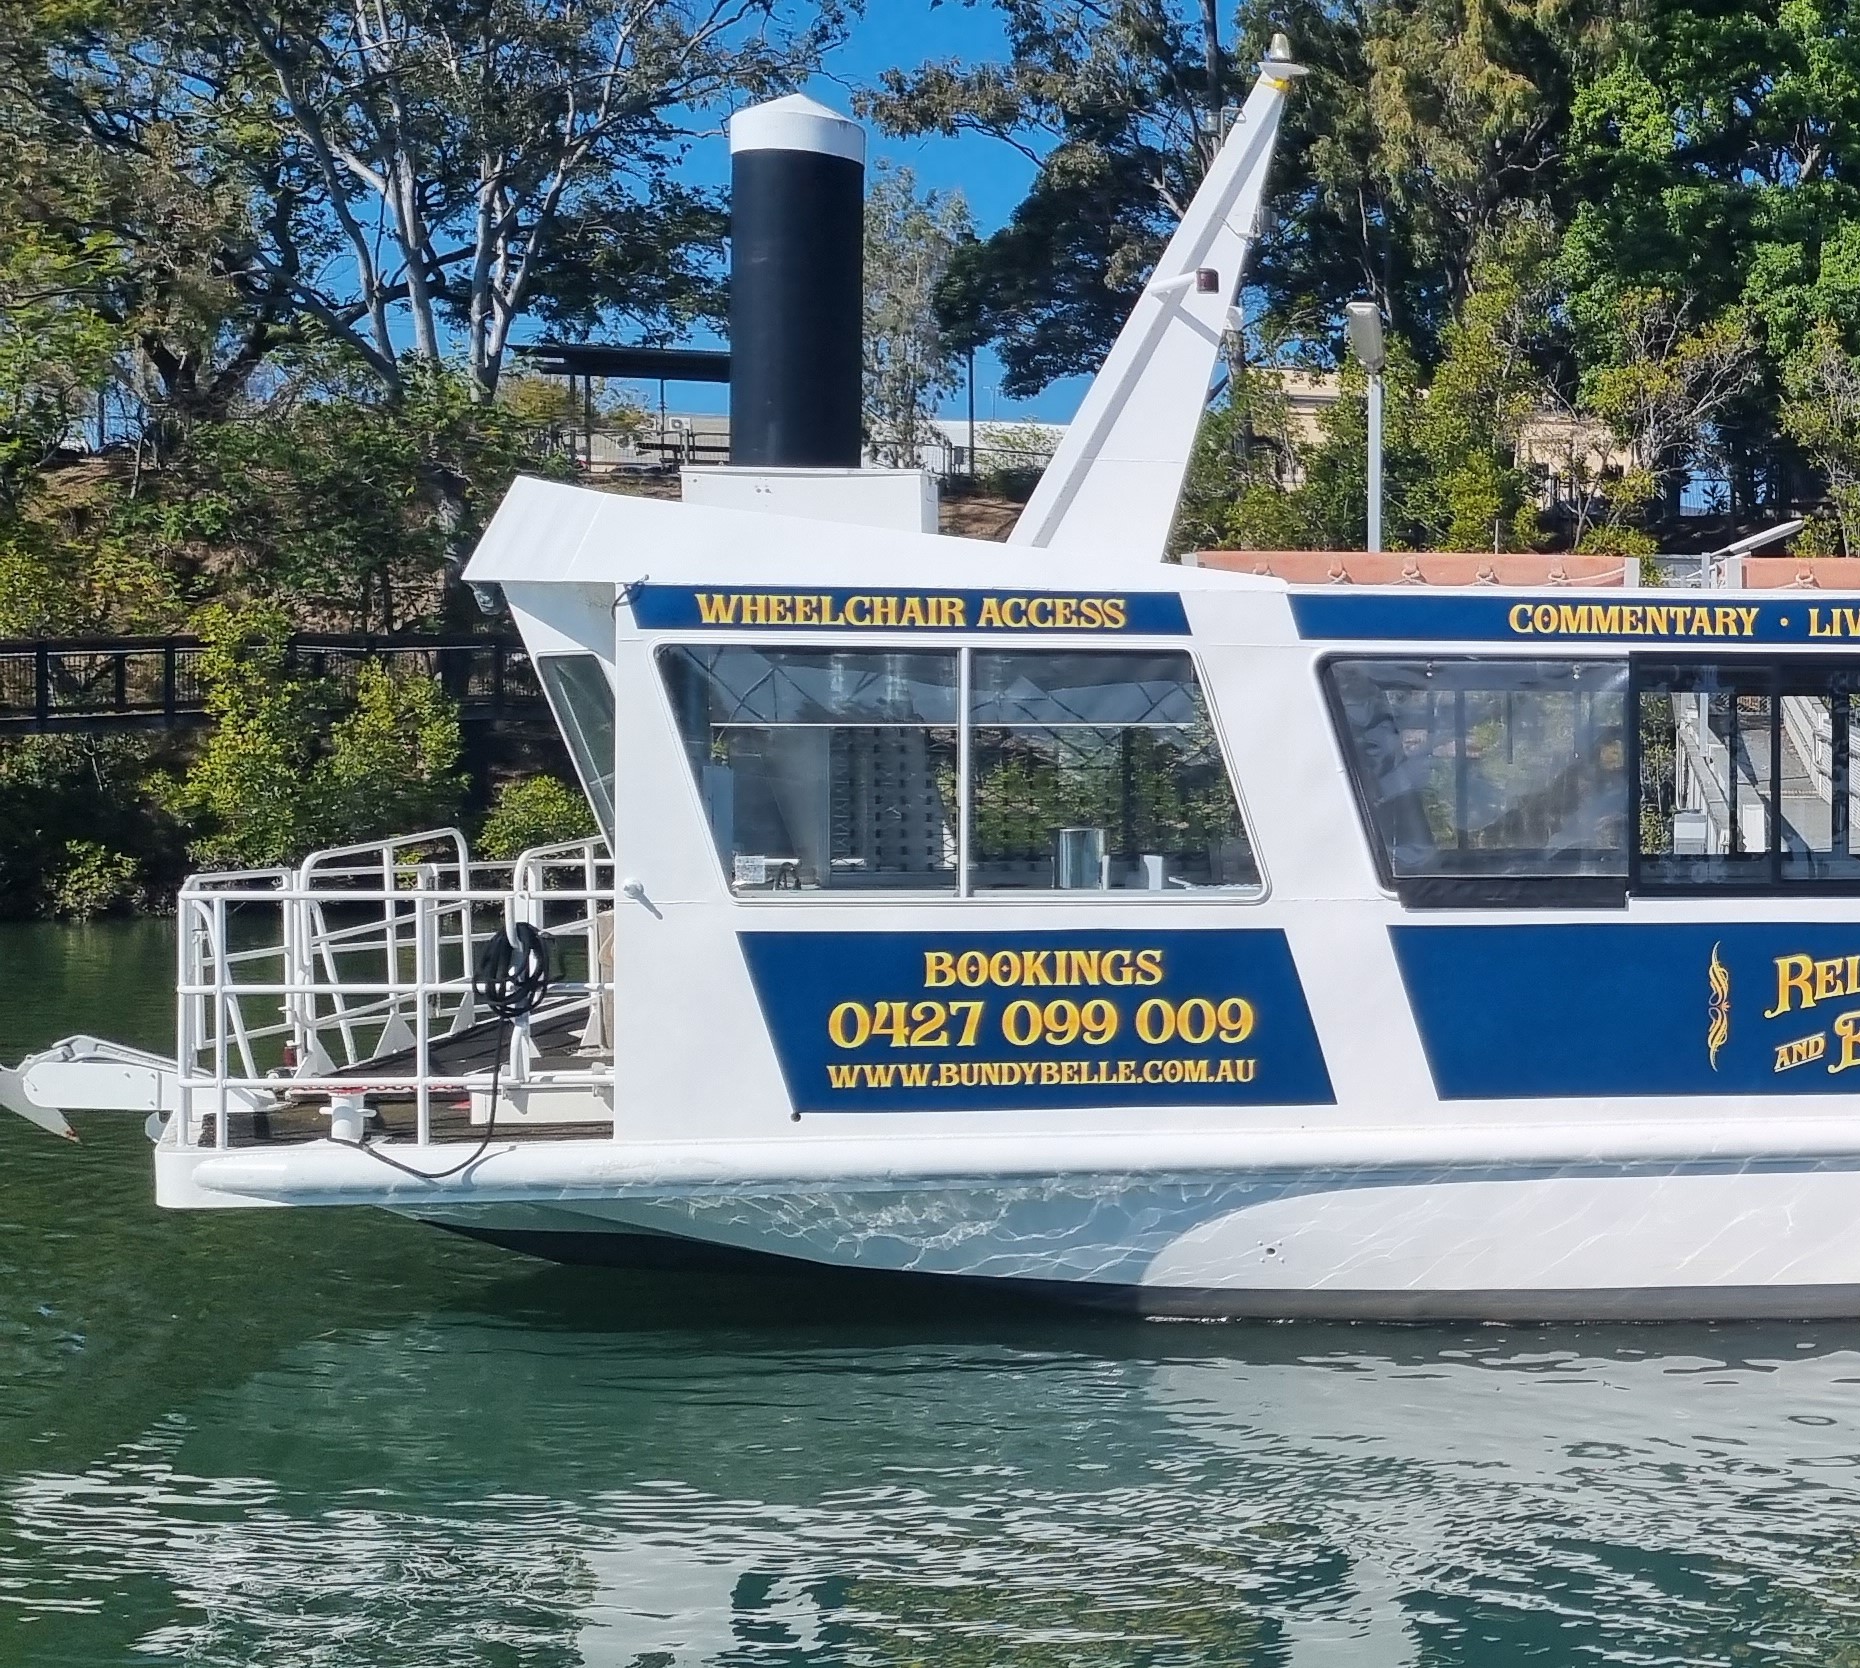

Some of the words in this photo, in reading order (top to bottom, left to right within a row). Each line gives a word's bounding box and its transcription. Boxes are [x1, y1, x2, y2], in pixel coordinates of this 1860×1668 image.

[695, 593, 965, 629] WHEELCHAIR
[978, 597, 1127, 630] ACCESS
[1508, 604, 1760, 637] COMMENTARY
[923, 949, 1164, 988] BOOKINGS
[827, 1000, 984, 1048] 0427
[1001, 998, 1119, 1046] 099
[1134, 996, 1256, 1045] 009
[1773, 1031, 1826, 1073] AND
[826, 1057, 1257, 1089] WWW.BUNDYBELLE.COM.AU
